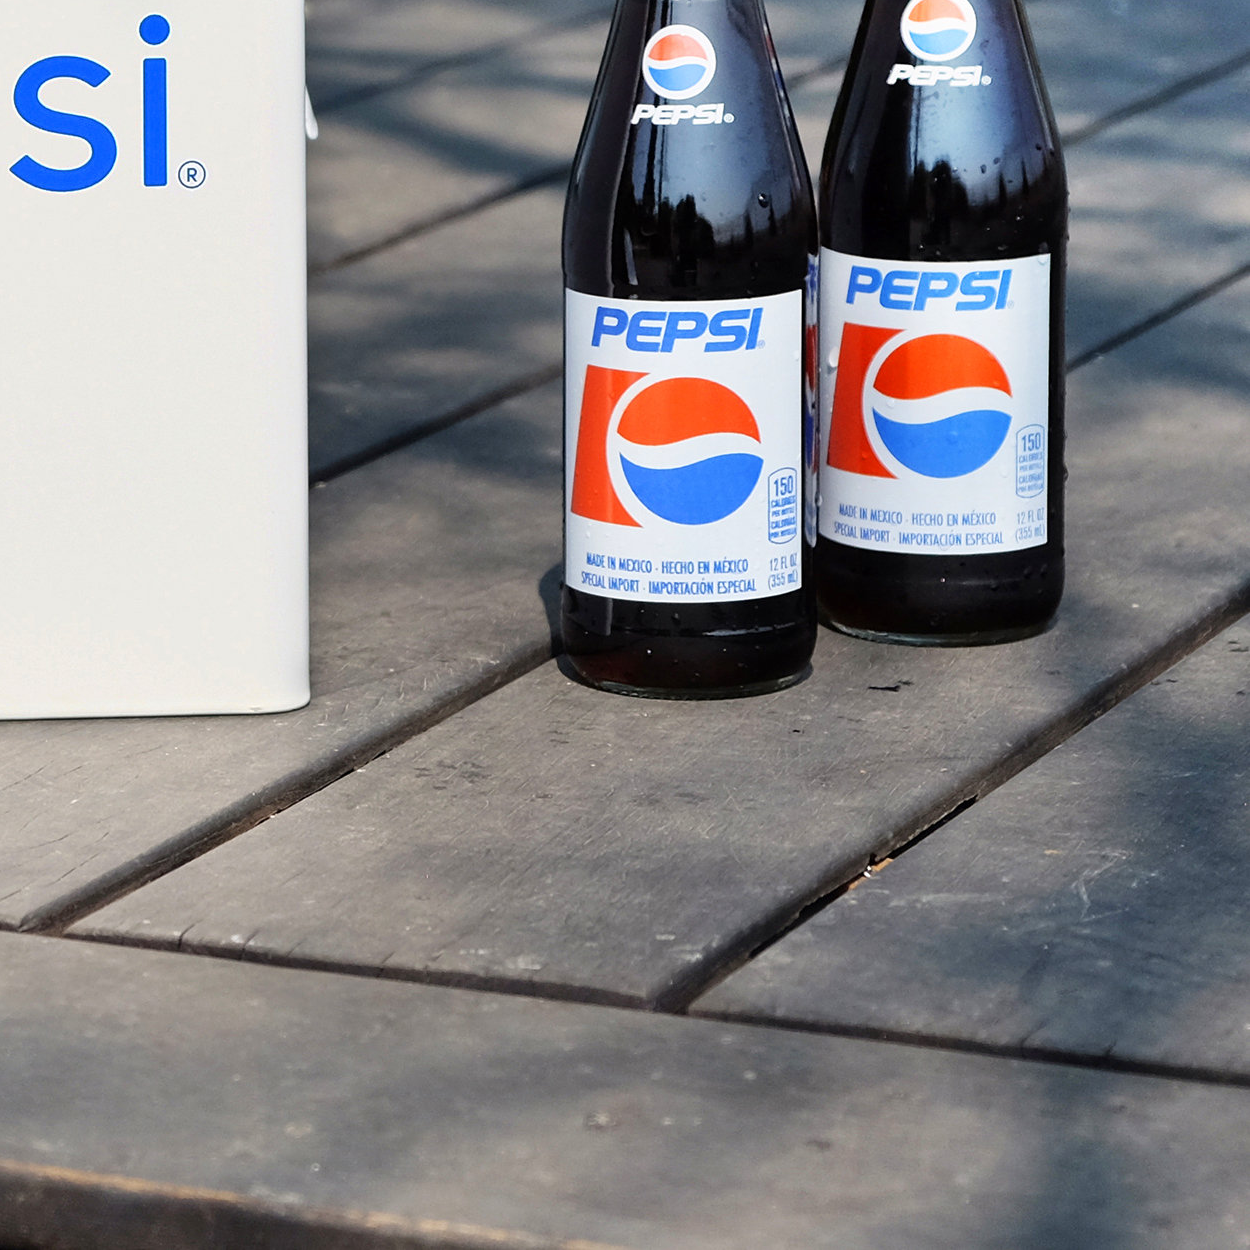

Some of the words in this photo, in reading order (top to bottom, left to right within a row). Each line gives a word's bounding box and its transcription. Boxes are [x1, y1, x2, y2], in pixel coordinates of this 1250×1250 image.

[886, 63, 983, 86] PEPSI
[630, 103, 725, 125] PEPSI
[846, 265, 1013, 311] PEPSI
[591, 306, 764, 353] PEPSI
[1021, 432, 1041, 452] 150
[773, 475, 793, 497] 150
[839, 503, 857, 518] MADE
[859, 507, 867, 520] IN
[870, 509, 903, 525] MEXICO
[911, 512, 943, 526] HECHO
[946, 513, 959, 527] EN
[1016, 511, 1026, 524] 12
[834, 521, 857, 538] SPECIAL
[859, 526, 890, 543] IMPORT
[965, 531, 1003, 546] ESPECIAL
[586, 552, 605, 568] MADE
[608, 556, 616, 570] IN
[619, 558, 652, 573] MEXICO
[661, 561, 694, 574] HECHO
[698, 561, 710, 574] EN
[713, 556, 748, 574] MÉXICO
[769, 559, 779, 571] 12
[781, 556, 788, 570] FL
[581, 571, 606, 589] SPECIAL
[608, 577, 640, 592] IMPORT
[648, 578, 714, 595] IMPORTACIÓN
[717, 578, 757, 595] ESPECIAL
